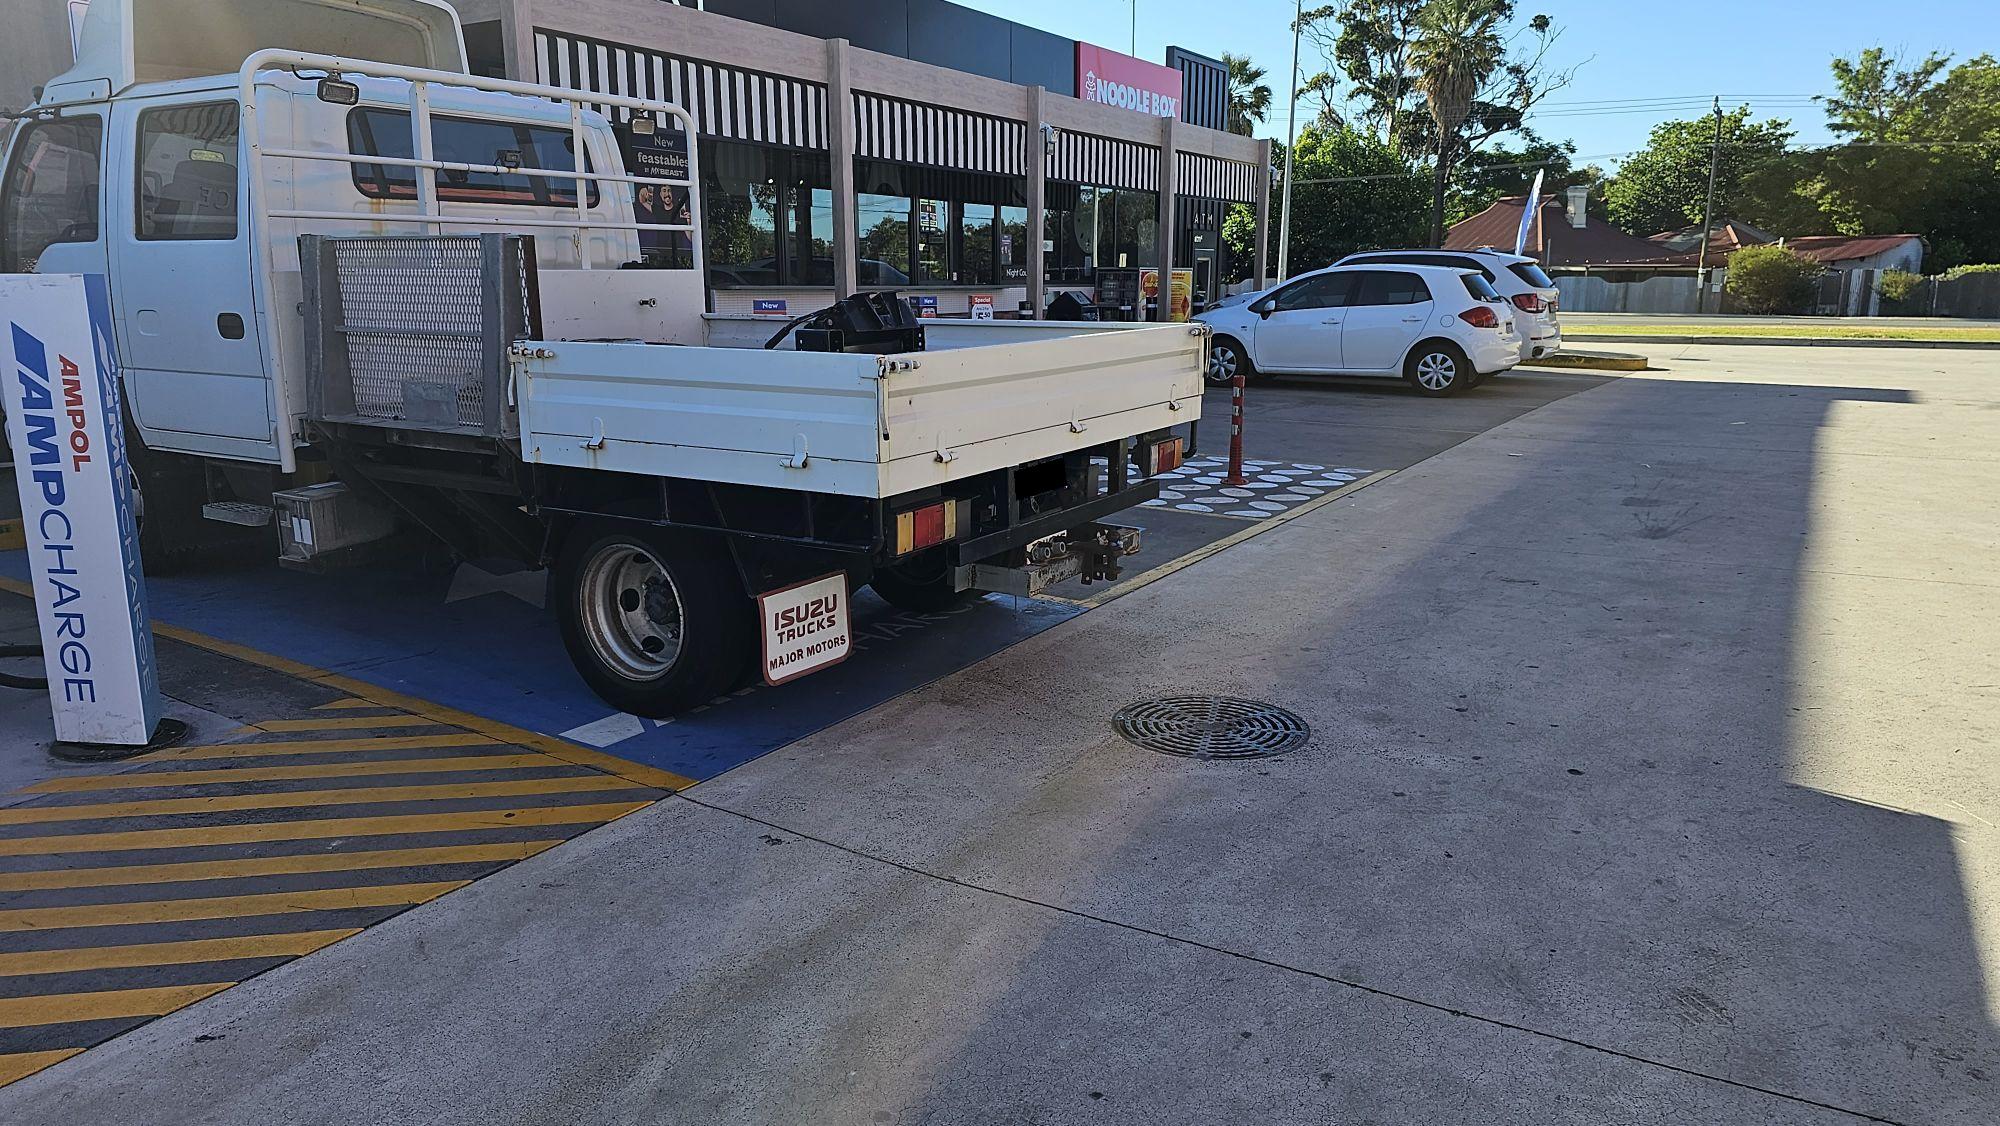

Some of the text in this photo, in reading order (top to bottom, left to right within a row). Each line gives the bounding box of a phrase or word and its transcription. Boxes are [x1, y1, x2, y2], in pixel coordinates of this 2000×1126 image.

[1097, 78, 1177, 118] NOODLE BOX
[637, 151, 689, 168] feastables
[654, 136, 674, 148] New
[1194, 212, 1213, 225] ATM
[762, 301, 779, 310] New
[59, 353, 91, 473] AMPOL
[17, 368, 96, 703] AMPCHARGE
[102, 369, 151, 697] AMPCHARGE
[774, 593, 838, 631] ISUZU
[777, 614, 837, 645] TRUCKS
[769, 634, 847, 672] MAJOR MOTORS
